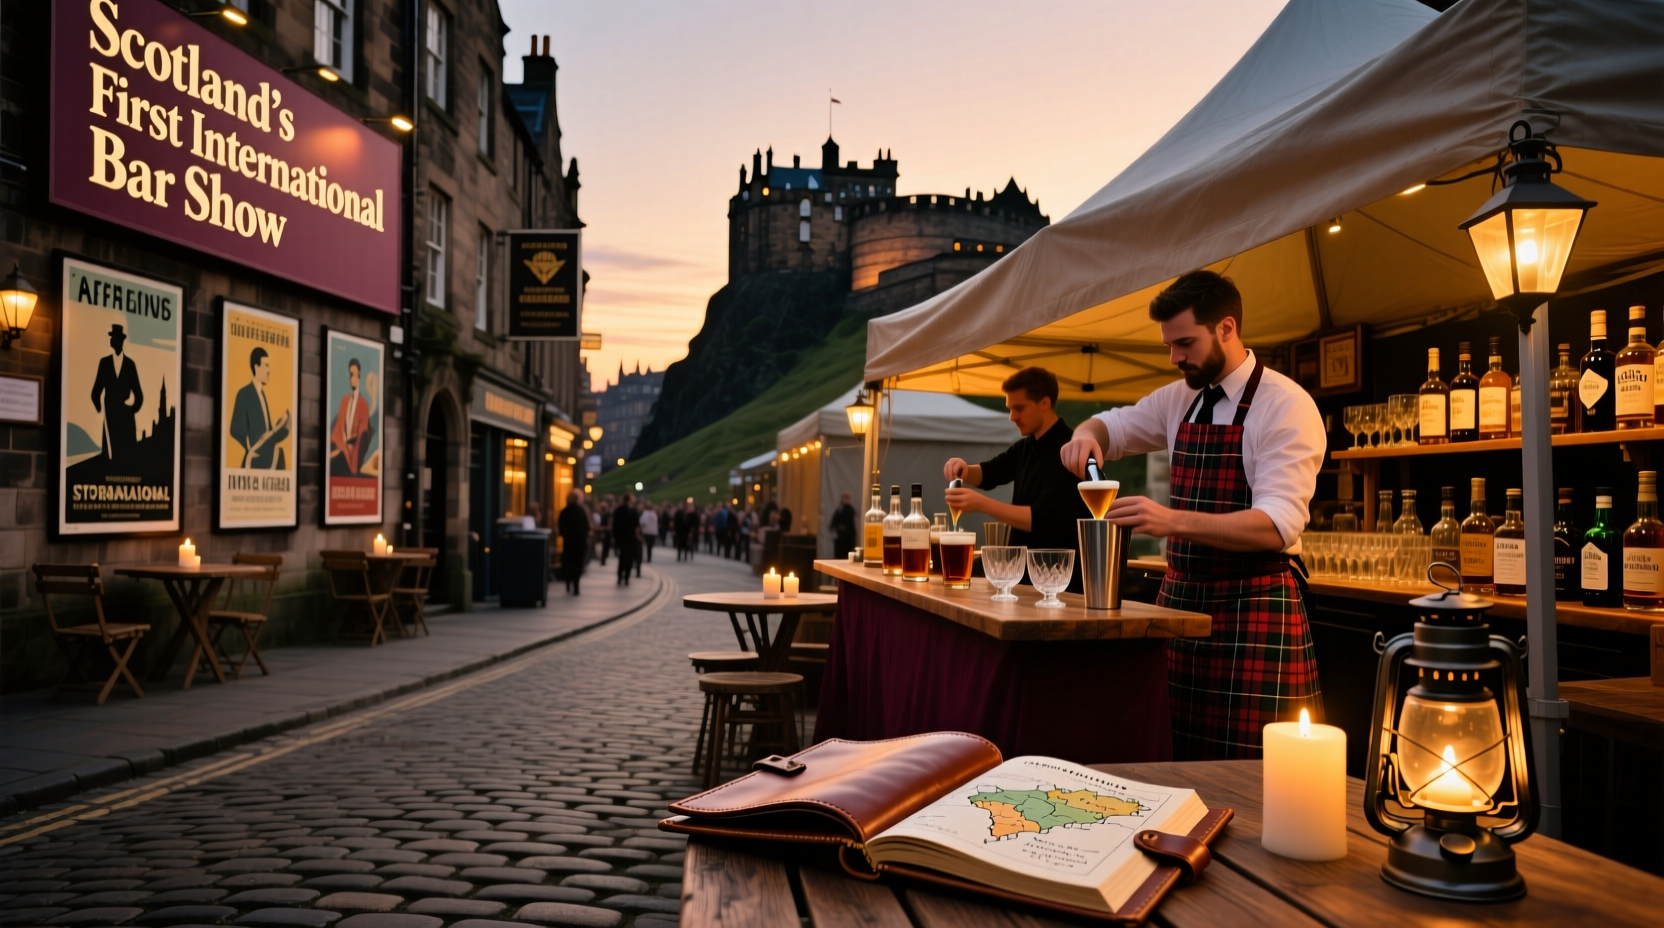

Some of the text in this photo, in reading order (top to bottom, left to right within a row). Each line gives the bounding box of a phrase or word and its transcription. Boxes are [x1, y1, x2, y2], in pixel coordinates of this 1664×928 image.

[89, 0, 295, 142] Scotland's
[89, 62, 385, 233] First International
[89, 125, 288, 248] Bar Show
